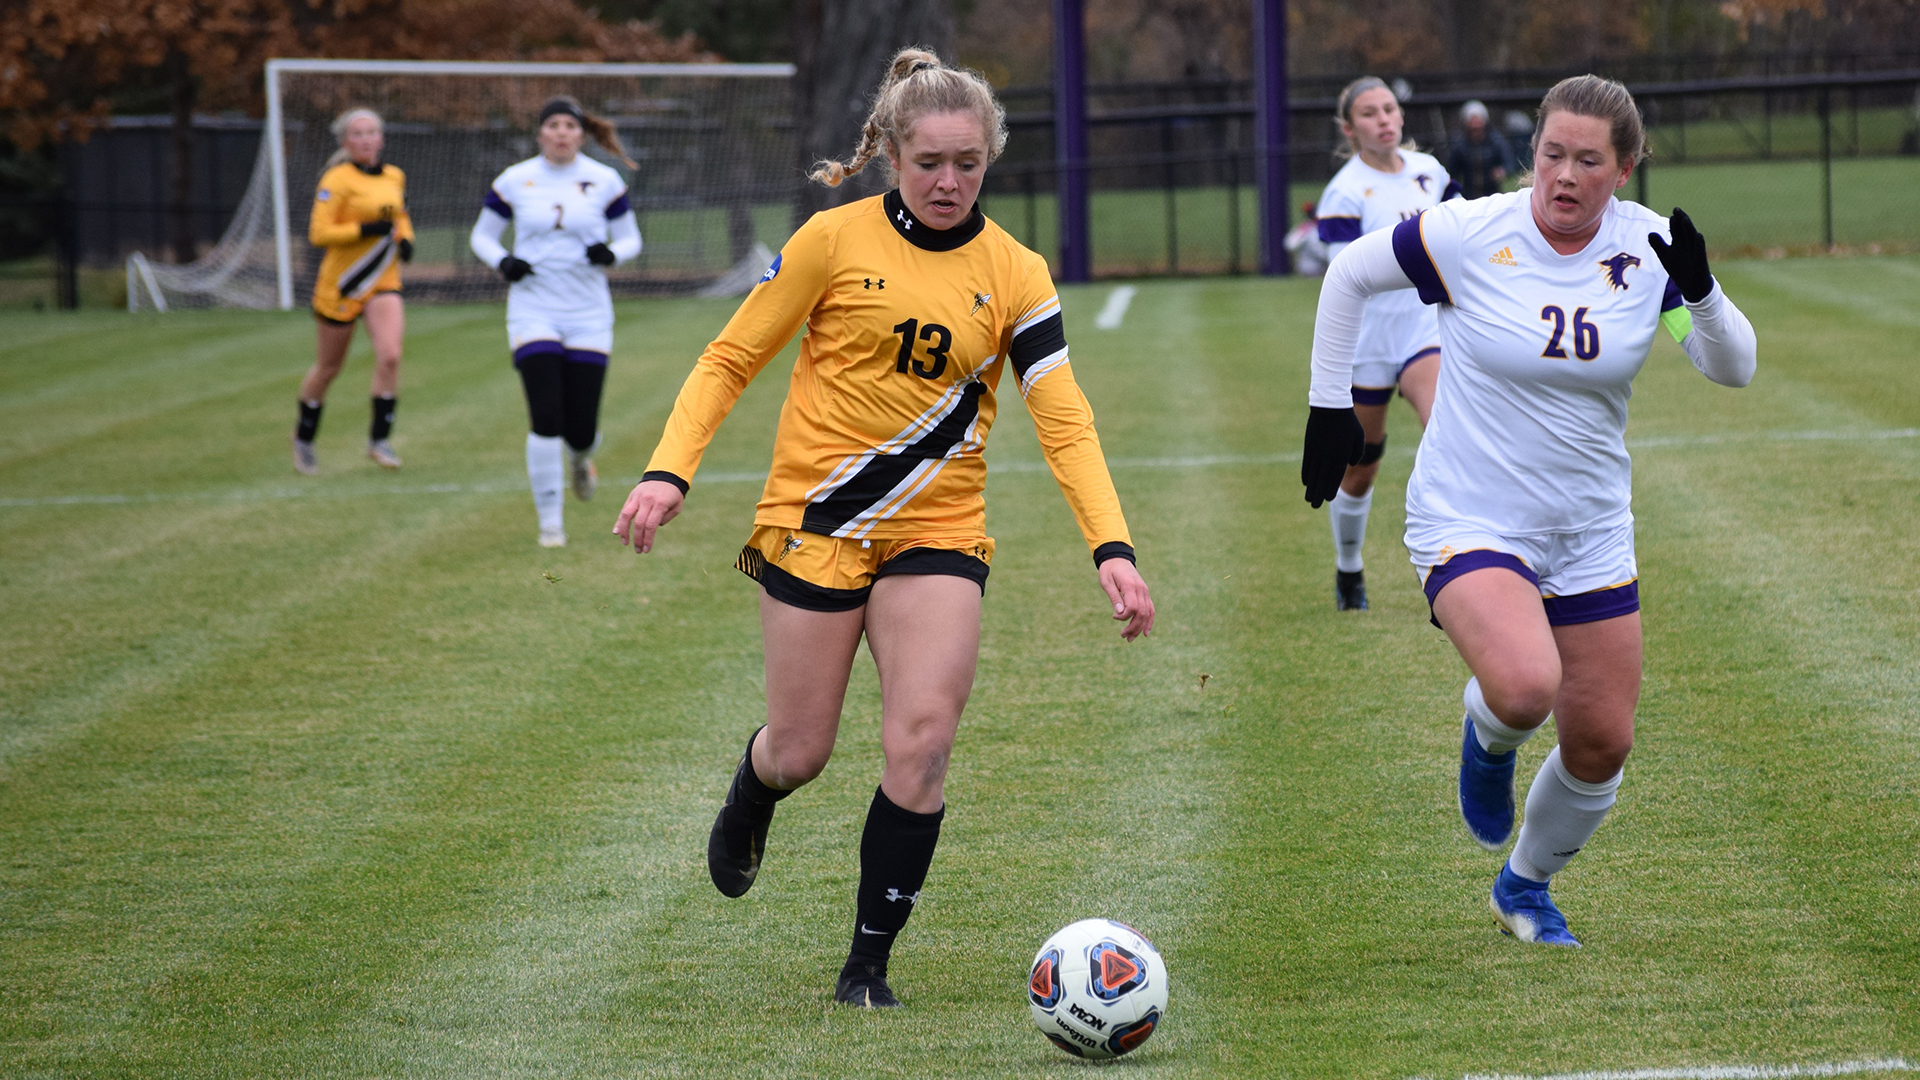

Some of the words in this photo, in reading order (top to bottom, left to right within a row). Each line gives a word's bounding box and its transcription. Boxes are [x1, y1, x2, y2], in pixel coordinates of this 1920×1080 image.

[552, 204, 565, 231] 2
[1488, 257, 1518, 267] adidas
[1540, 304, 1601, 361] 26
[893, 317, 953, 380] 13
[1068, 1003, 1108, 1031] NCAA
[1055, 1016, 1098, 1049] Wilson
